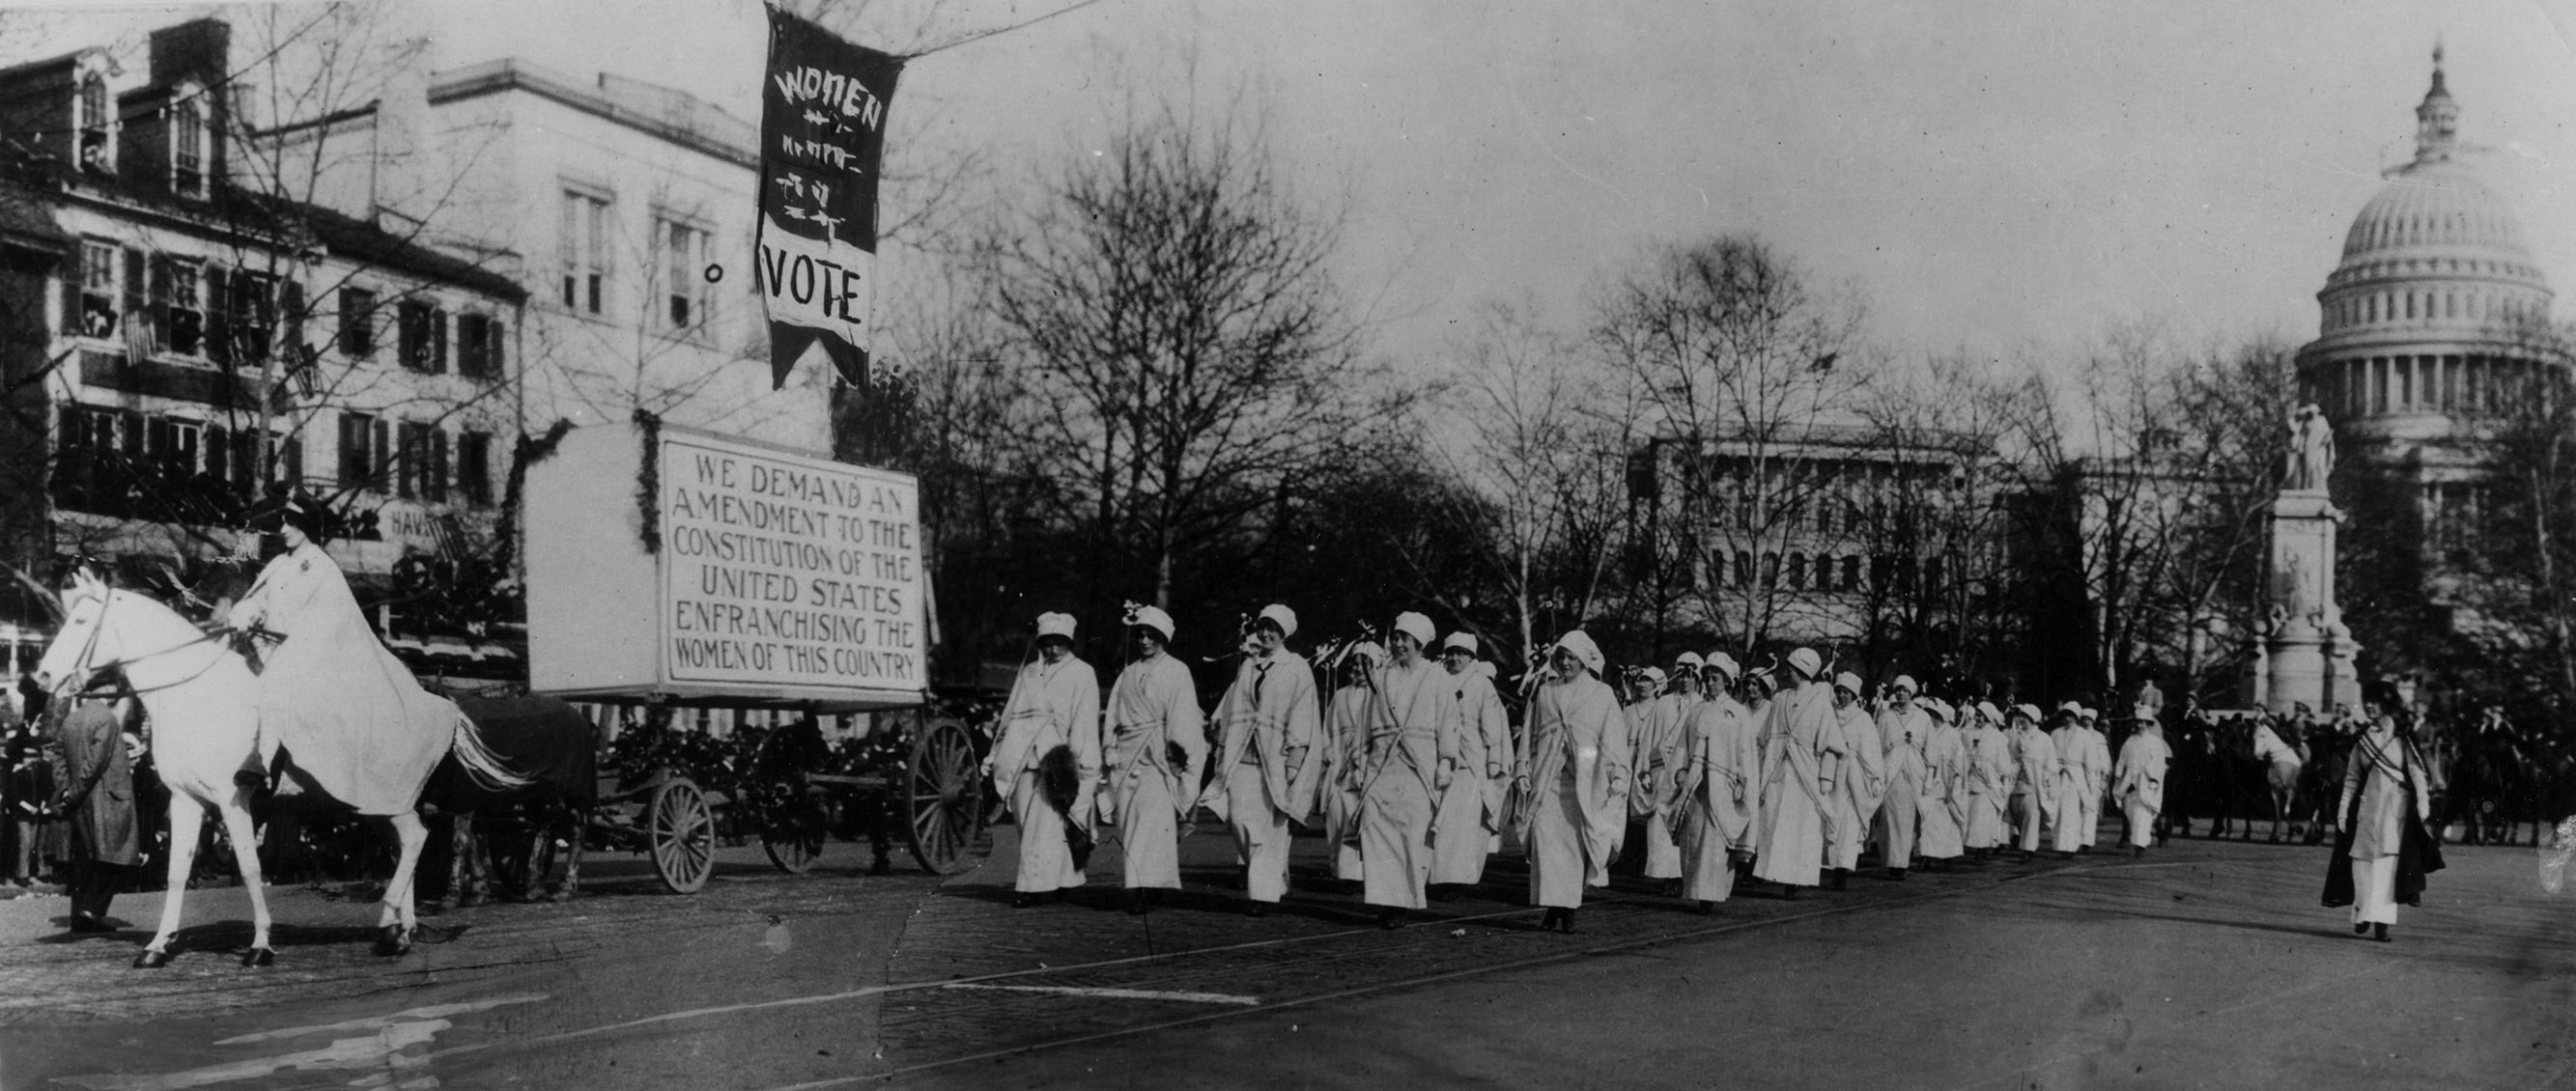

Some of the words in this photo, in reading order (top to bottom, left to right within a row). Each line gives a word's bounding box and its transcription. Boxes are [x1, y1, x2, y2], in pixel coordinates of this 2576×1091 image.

[775, 66, 882, 132] WOMEN
[762, 243, 861, 324] VOTE
[695, 454, 735, 489] WE
[751, 464, 861, 509] DEMAND
[868, 487, 902, 513] AN
[672, 488, 829, 539] AMENDMENT
[838, 515, 863, 544] TO
[869, 519, 912, 550] THE
[675, 525, 833, 573] CONSTITUTION
[839, 548, 863, 576] OF
[871, 552, 913, 583] THE
[702, 564, 798, 602] UNITED
[811, 578, 901, 615] STATES
[676, 601, 866, 644] ENFRANCHISING
[874, 619, 914, 649] THE
[675, 638, 748, 669] WOMEN
[752, 642, 777, 671] OF
[784, 644, 829, 674] THIS
[834, 648, 915, 680] COUNTRY
